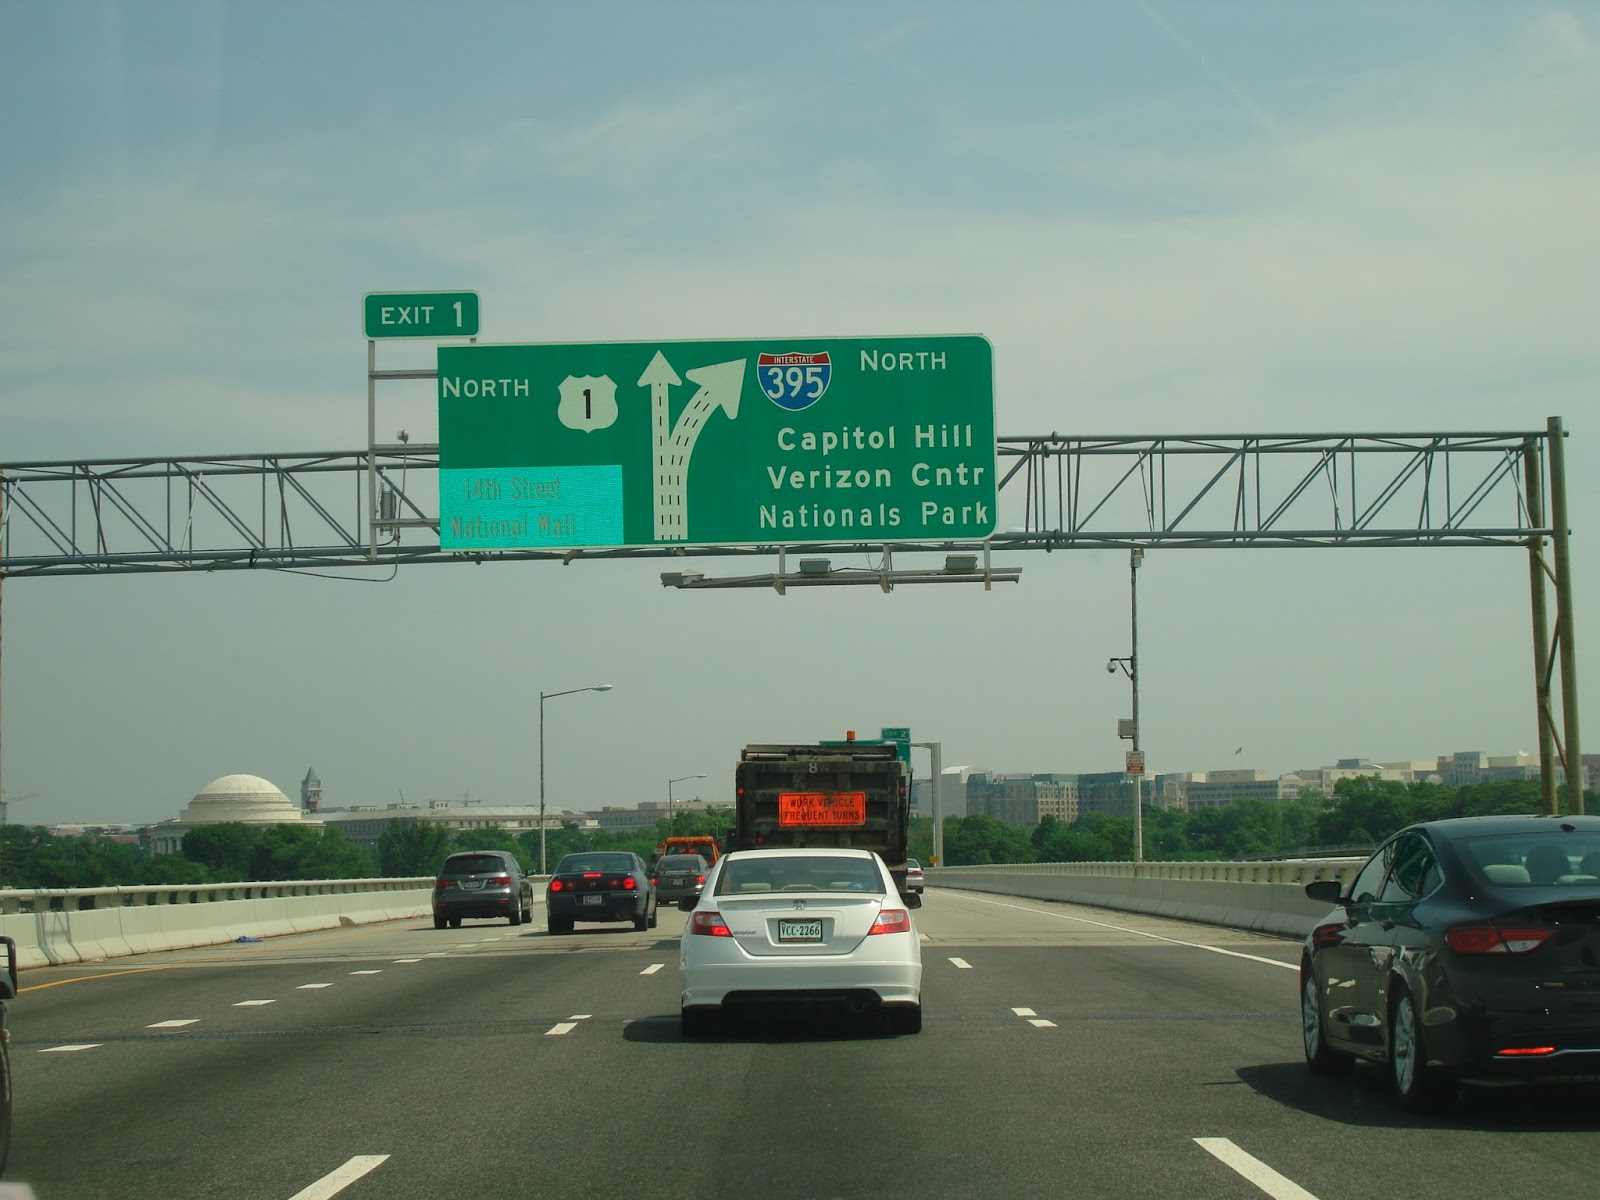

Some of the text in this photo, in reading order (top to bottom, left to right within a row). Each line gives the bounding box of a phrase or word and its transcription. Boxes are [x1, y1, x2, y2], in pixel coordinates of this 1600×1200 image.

[381, 301, 463, 328] EXIT 1
[773, 356, 815, 364] INTERSTATE
[860, 350, 947, 372] NORTH
[442, 377, 530, 398] NORTH
[767, 367, 824, 399] 395
[582, 388, 592, 420] 1
[777, 424, 973, 456] Capitol Hill
[464, 475, 562, 501] 14th Street
[767, 462, 985, 489] Verizon Cntr
[450, 513, 576, 539] National Mall
[759, 501, 989, 529] Nationals Park
[808, 762, 818, 774] 8
[784, 810, 860, 821] FREQUENT TURNS
[789, 797, 855, 808] WORK VEHICLE
[781, 925, 820, 936] VCC-2266
